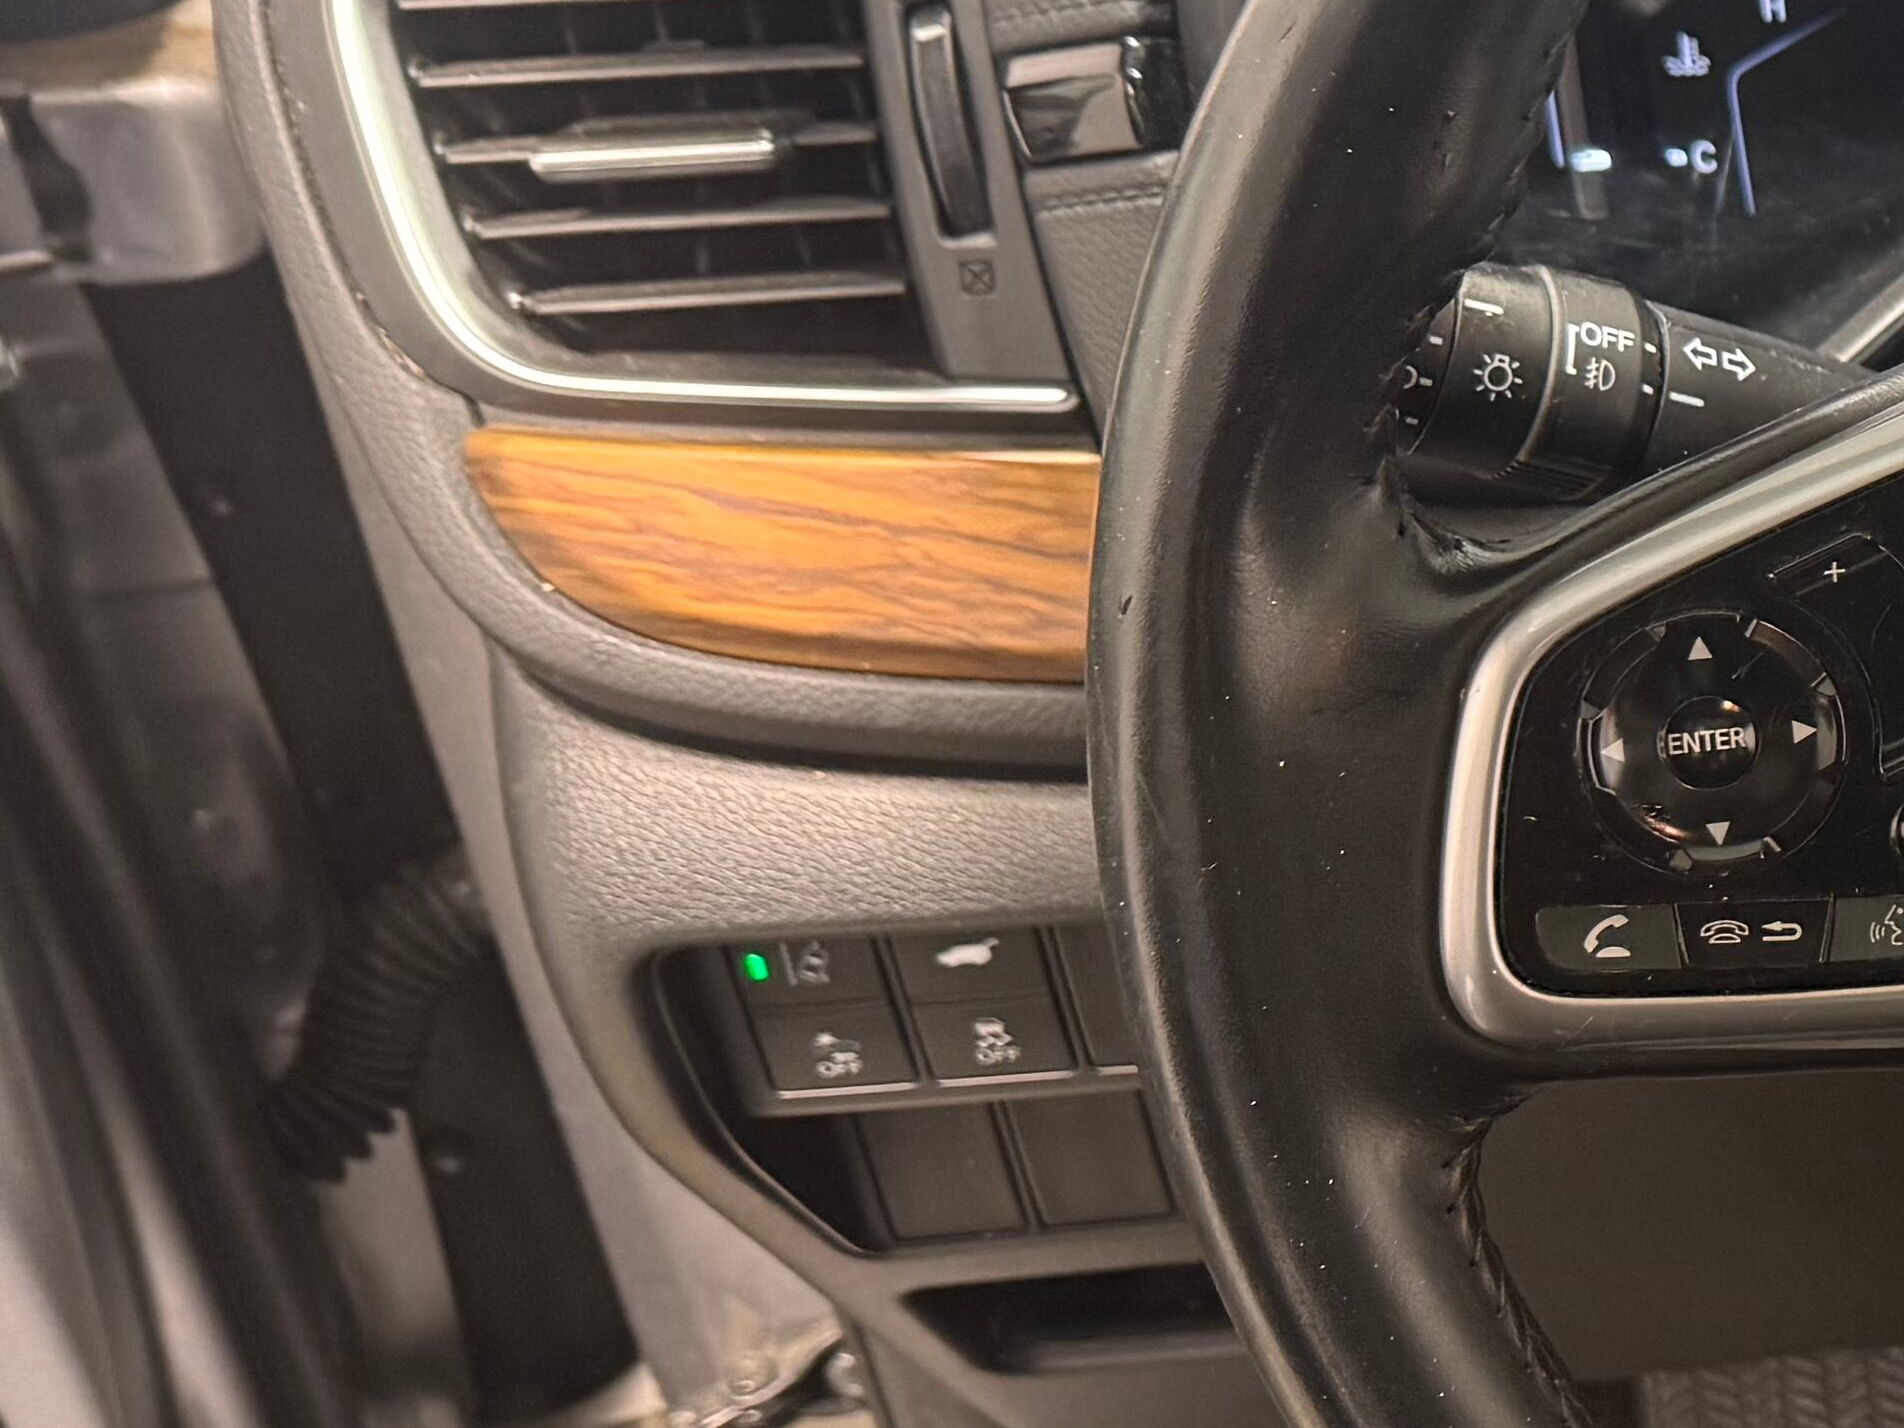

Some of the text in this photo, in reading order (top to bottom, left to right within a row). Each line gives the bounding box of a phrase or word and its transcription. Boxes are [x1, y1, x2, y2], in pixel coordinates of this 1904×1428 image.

[1690, 138, 1719, 174] C
[1580, 320, 1635, 353] OFF
[1666, 725, 1747, 757] ENTER
